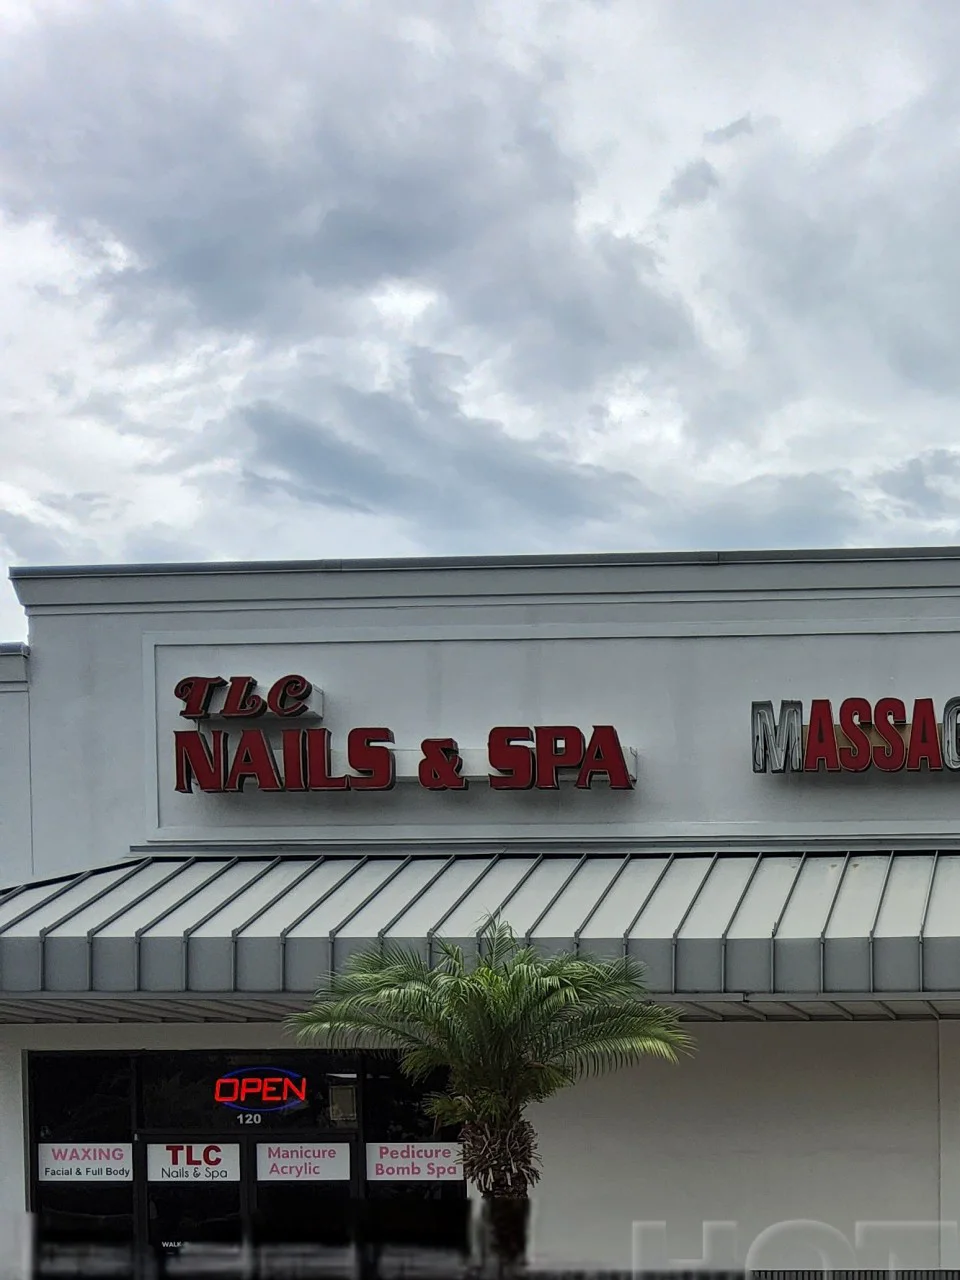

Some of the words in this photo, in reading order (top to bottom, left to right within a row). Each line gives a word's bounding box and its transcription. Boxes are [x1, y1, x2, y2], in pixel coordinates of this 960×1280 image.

[174, 674, 313, 720] TLC
[174, 727, 396, 793] NAILS
[418, 738, 468, 791] &
[488, 725, 635, 791] SPA
[214, 1077, 307, 1102] OPEN
[237, 1113, 262, 1125] 120
[51, 1147, 125, 1161] WAXING
[166, 1145, 222, 1166] TLC
[267, 1146, 337, 1160] Manicure
[379, 1146, 451, 1160] Pedicure
[44, 1167, 73, 1176] Facial
[75, 1167, 83, 1176] &
[85, 1167, 103, 1176] Full
[105, 1167, 130, 1178] Body
[161, 1167, 190, 1179] Nails
[192, 1167, 202, 1178] &
[204, 1167, 228, 1180] Spa
[269, 1162, 320, 1178] Acrylic
[375, 1163, 421, 1176] Bomb
[427, 1162, 457, 1179] Spa
